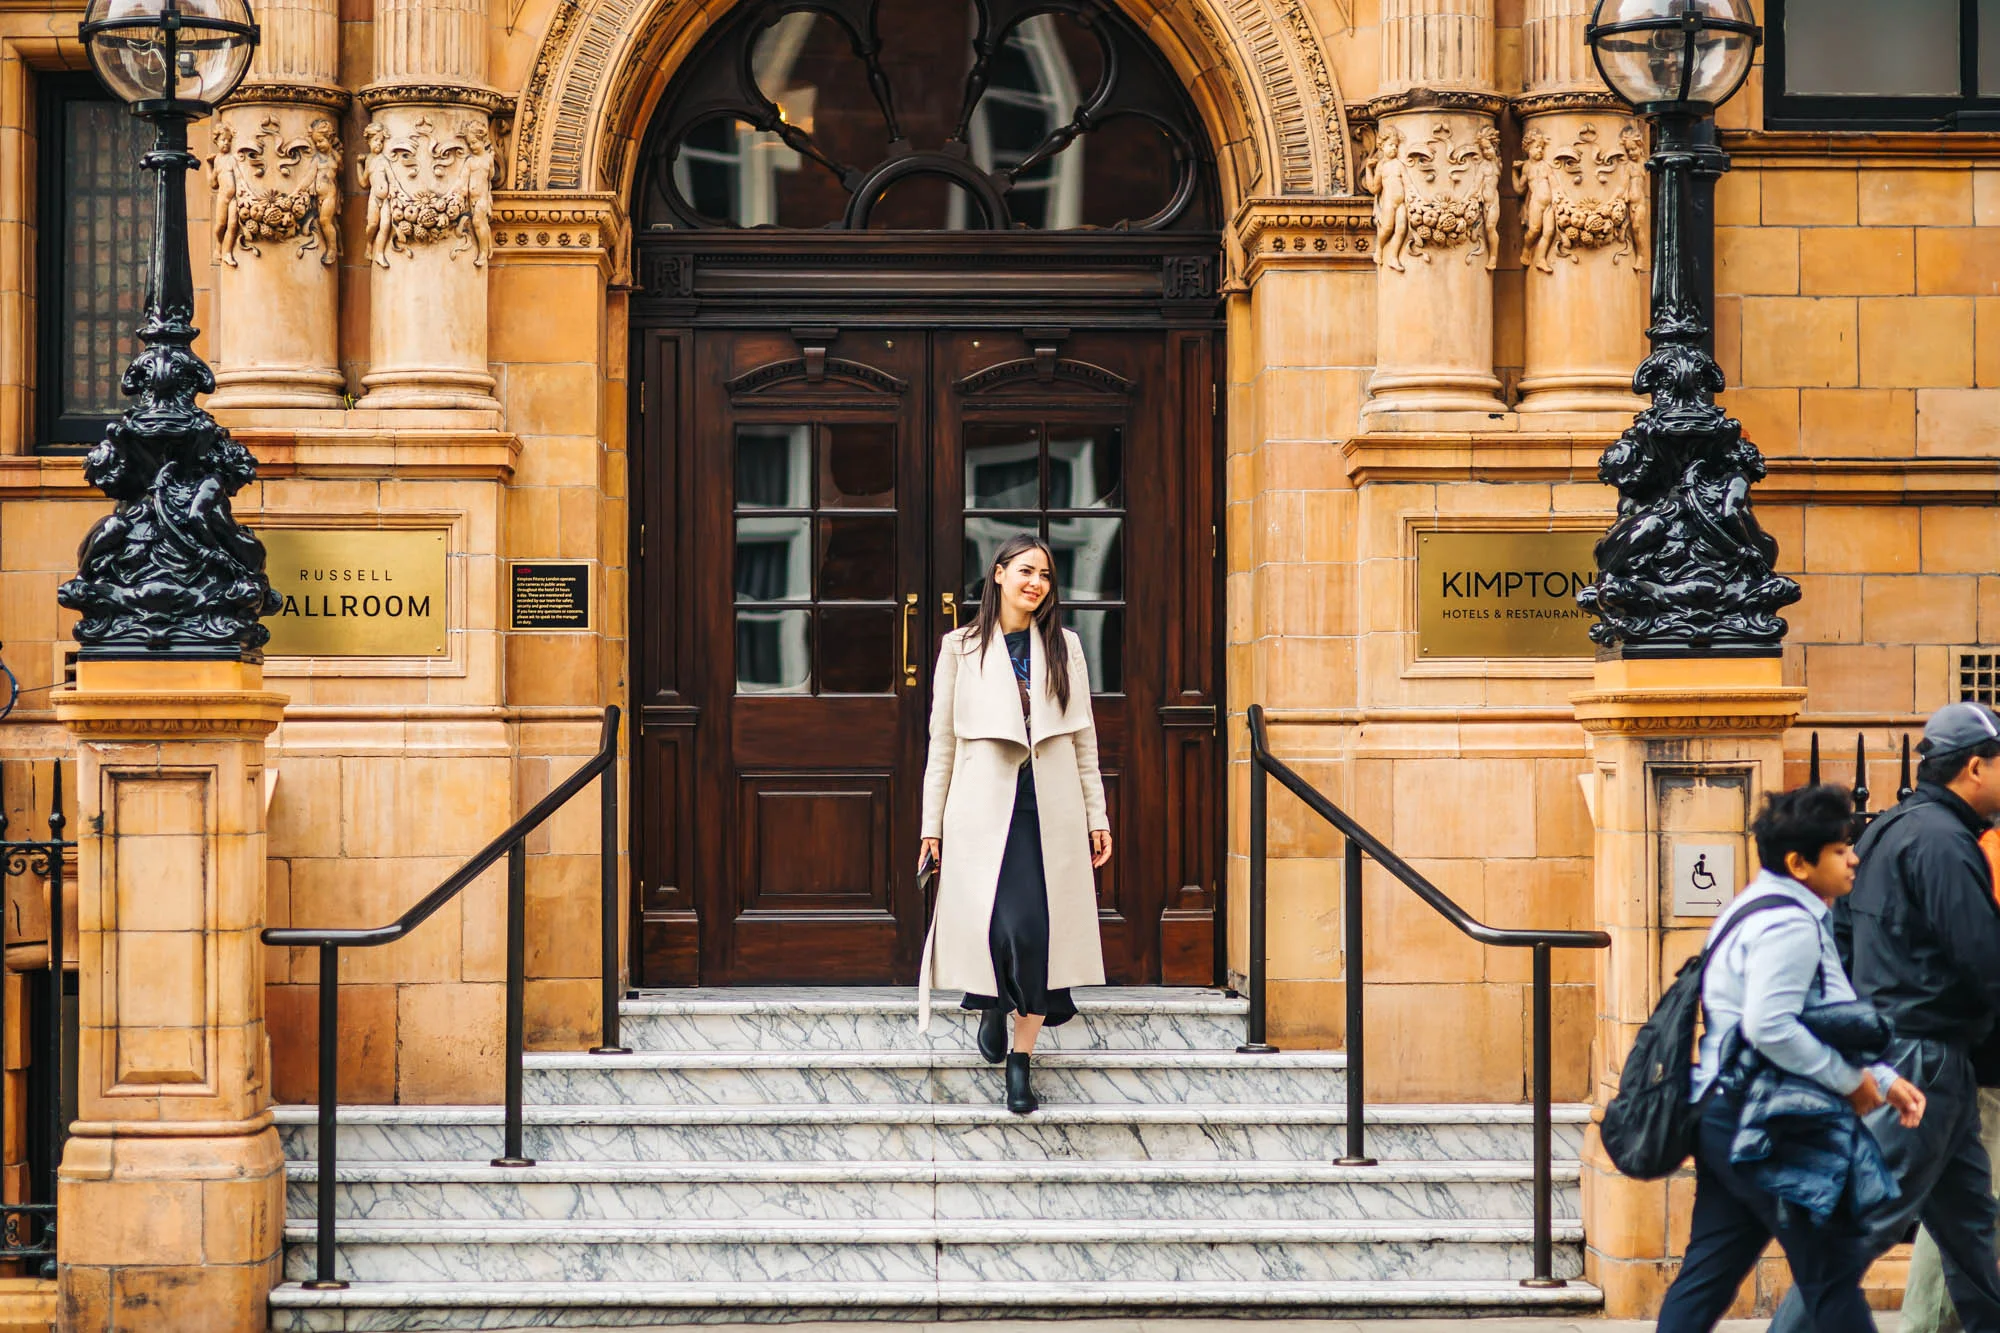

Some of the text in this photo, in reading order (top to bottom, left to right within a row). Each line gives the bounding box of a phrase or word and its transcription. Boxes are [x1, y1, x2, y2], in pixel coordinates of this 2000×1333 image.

[299, 569, 393, 581] RUSSELL
[1442, 571, 1593, 599] KIMPTON
[281, 595, 431, 617] ALLROOM
[1442, 609, 1490, 619] HOTELS
[1494, 609, 1502, 619] &
